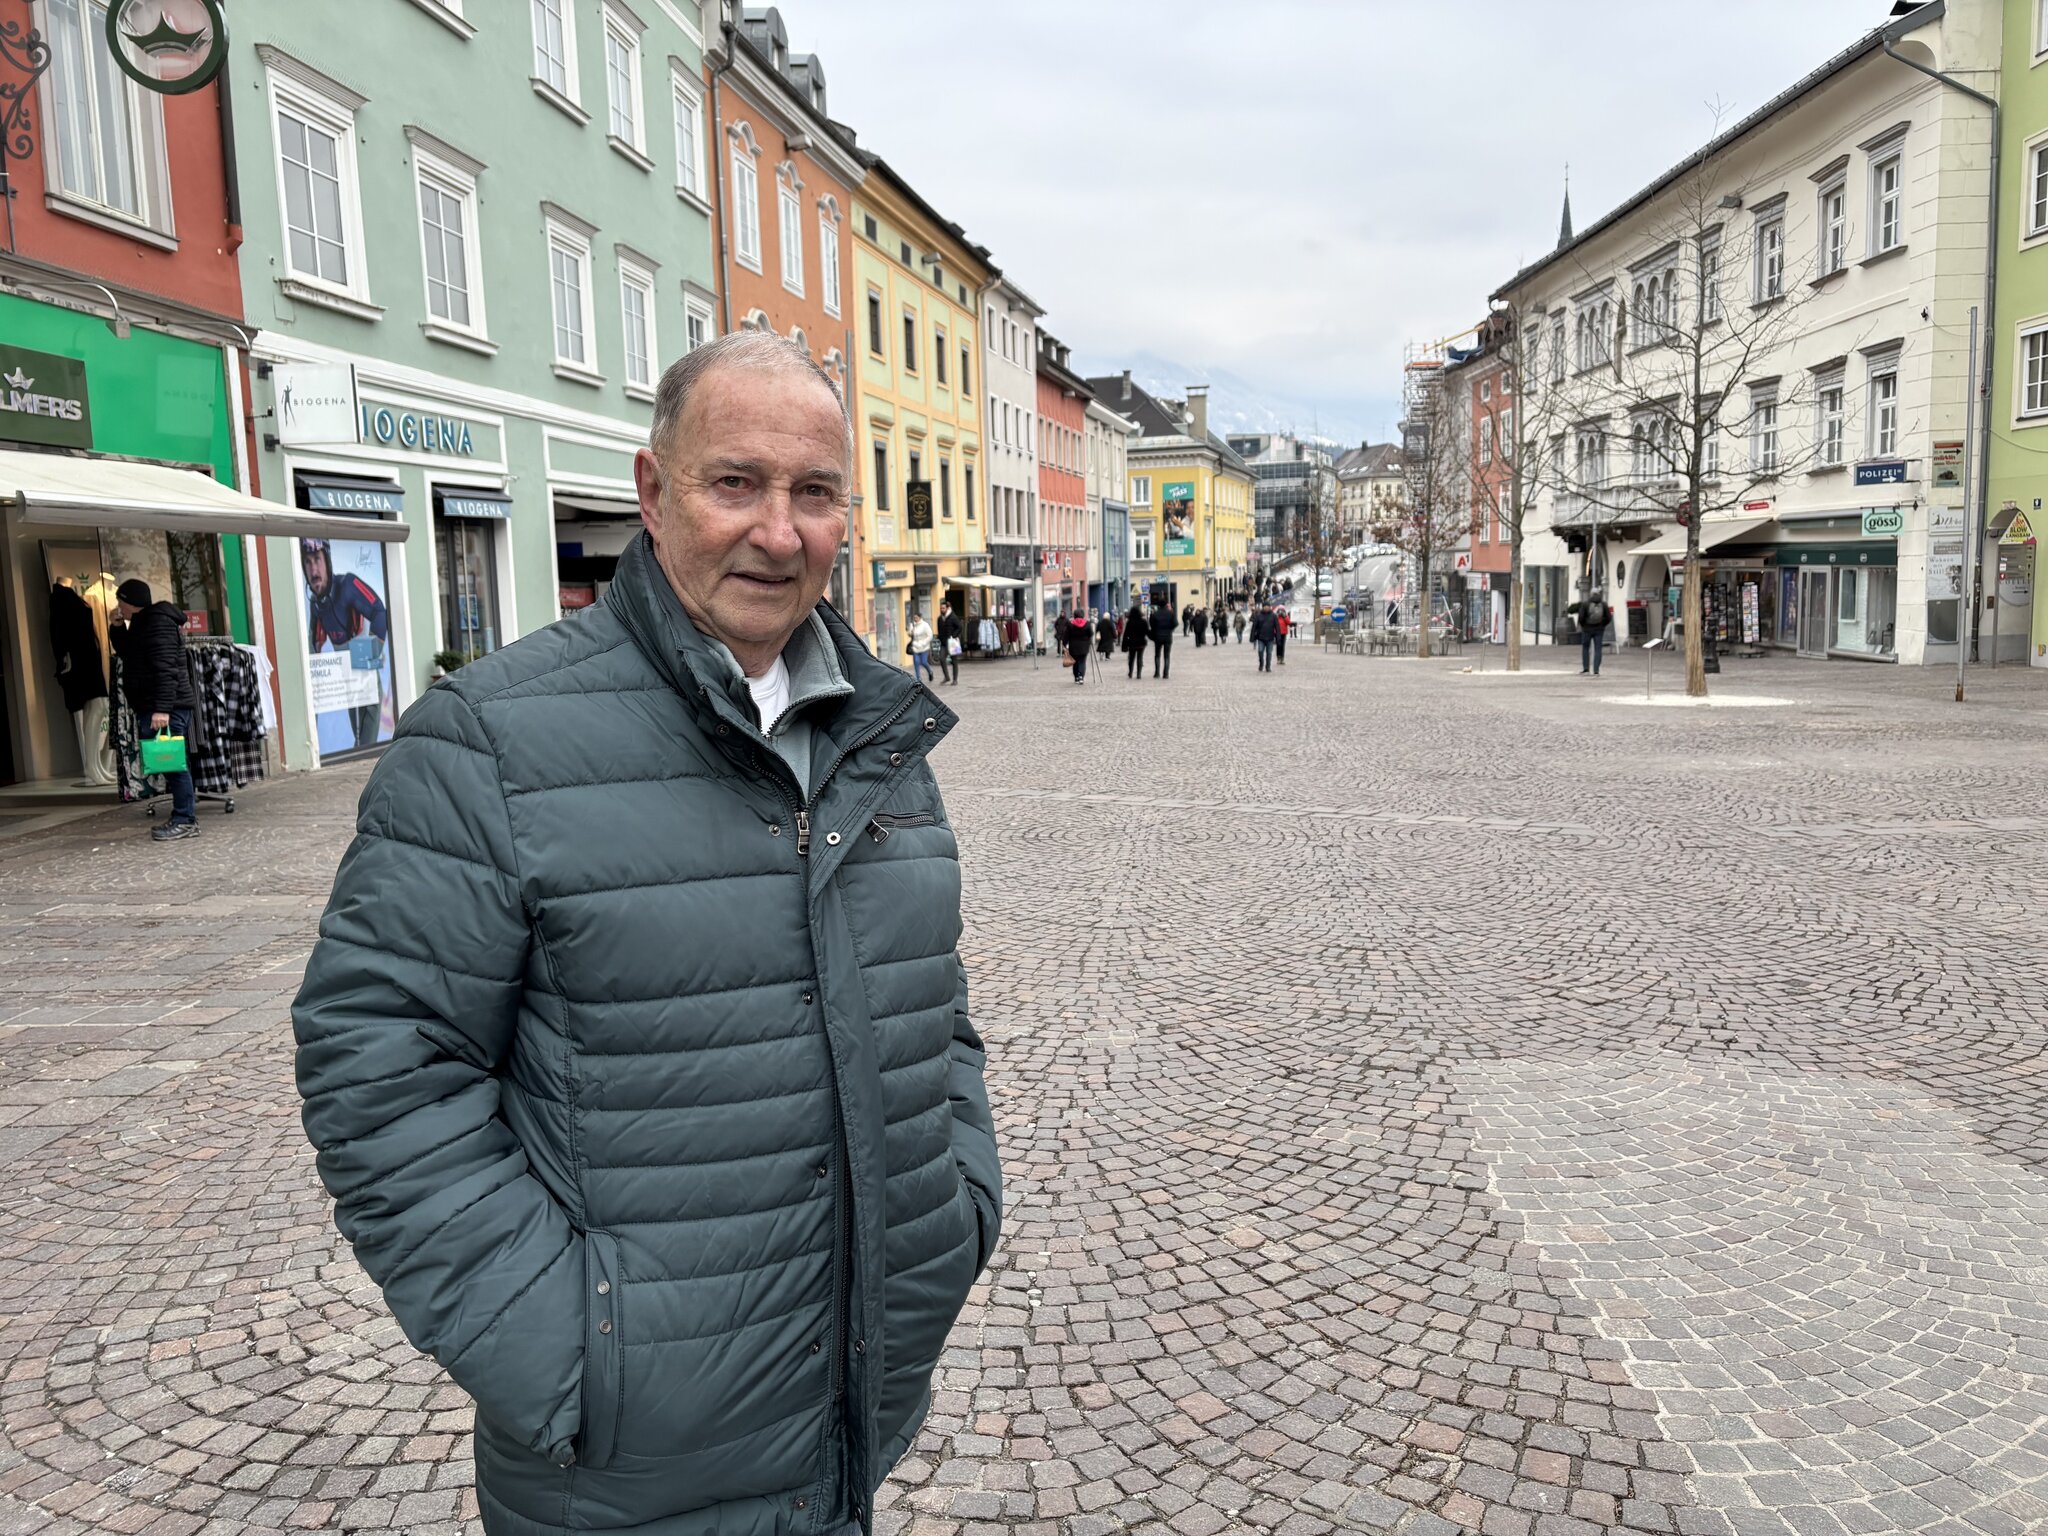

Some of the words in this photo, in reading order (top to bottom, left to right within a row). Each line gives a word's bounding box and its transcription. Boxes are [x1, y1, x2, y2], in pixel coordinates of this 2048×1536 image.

[293, 397, 346, 406] BIOGENA
[362, 404, 473, 454] IOGENA
[1859, 468, 1897, 479] POLIZEI
[327, 492, 392, 510] BIOGENA
[457, 501, 503, 516] BIOGENA
[1868, 516, 1898, 530] gössl
[309, 656, 343, 669] ERFORMANCE
[310, 669, 332, 678] ORMULA
